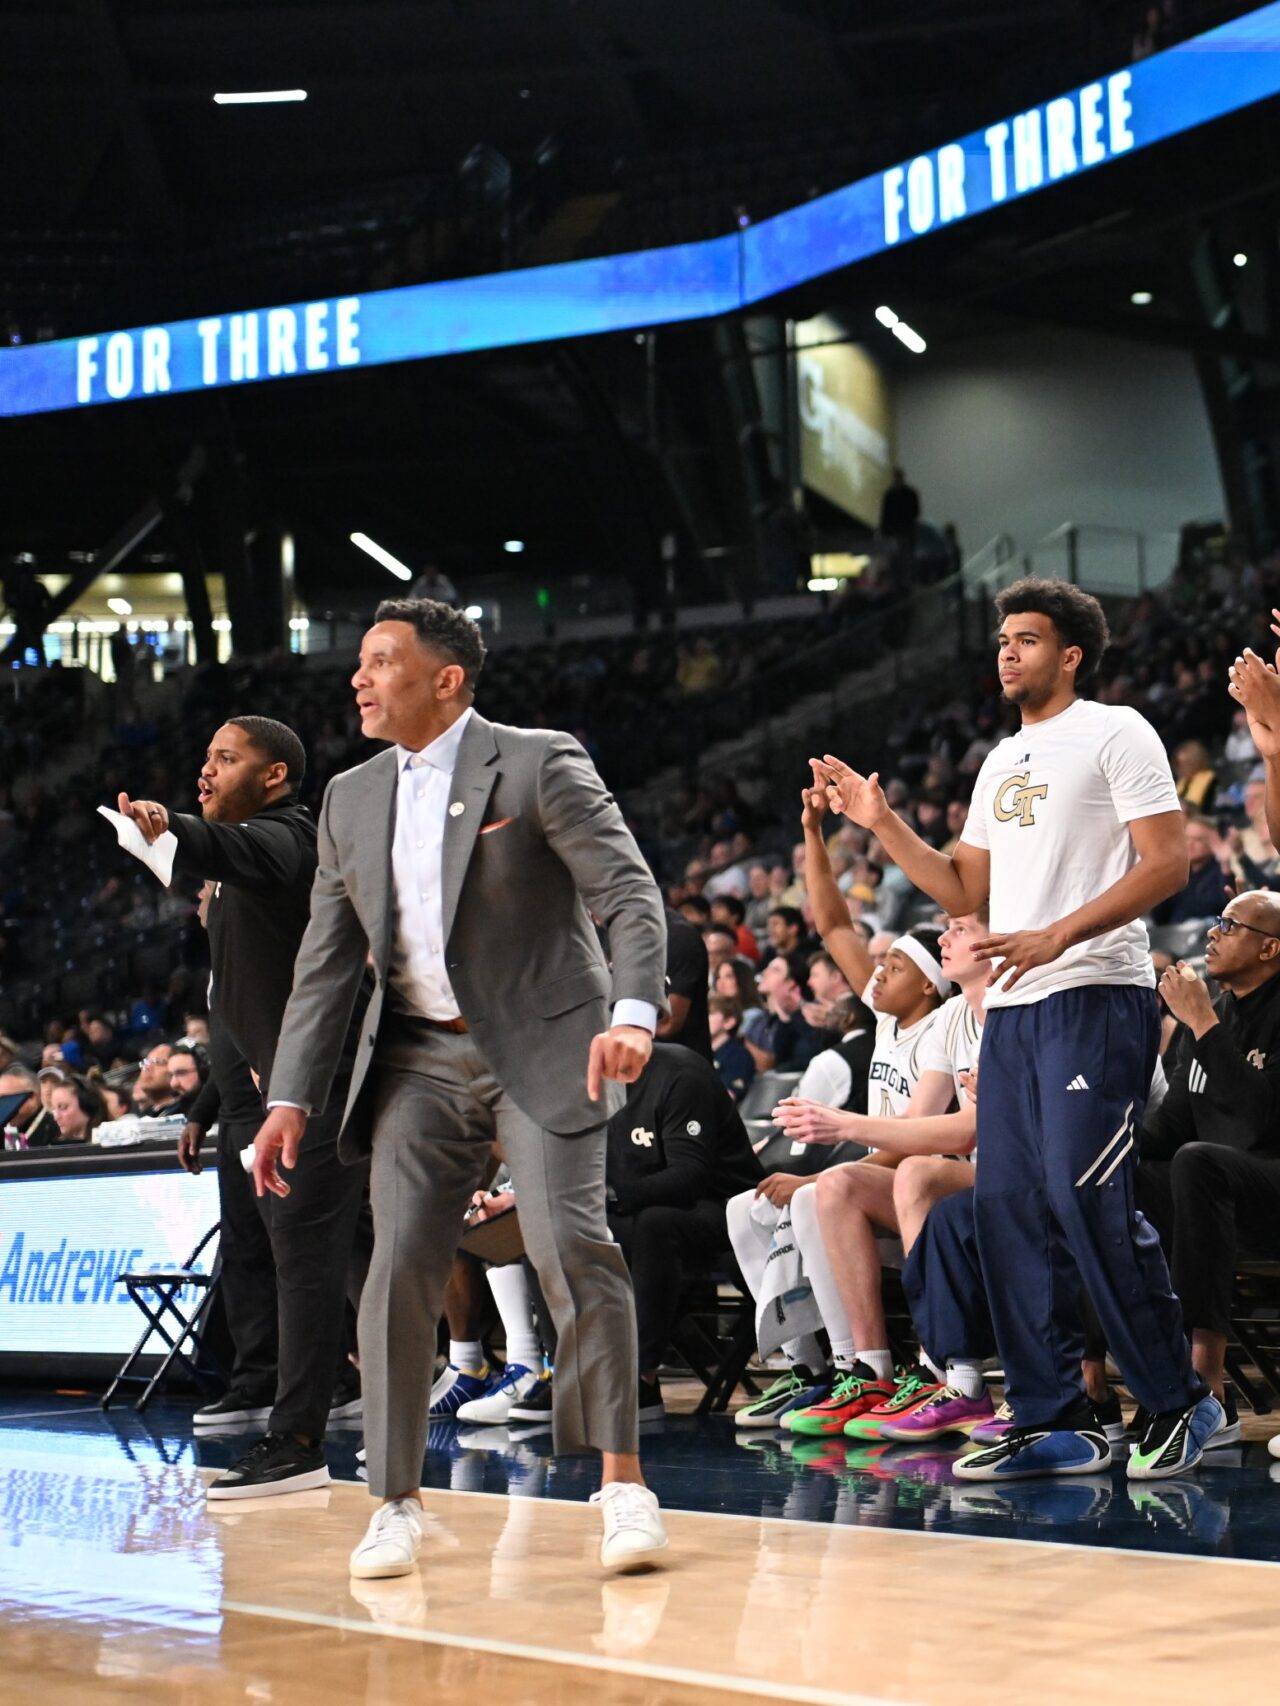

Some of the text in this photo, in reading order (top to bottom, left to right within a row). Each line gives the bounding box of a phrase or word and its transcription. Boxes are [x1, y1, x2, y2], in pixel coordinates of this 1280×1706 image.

[883, 70, 1135, 244] FOR THREE
[76, 297, 361, 403] FOR THREE
[993, 771, 1049, 828] GT
[630, 1126, 655, 1147] GT
